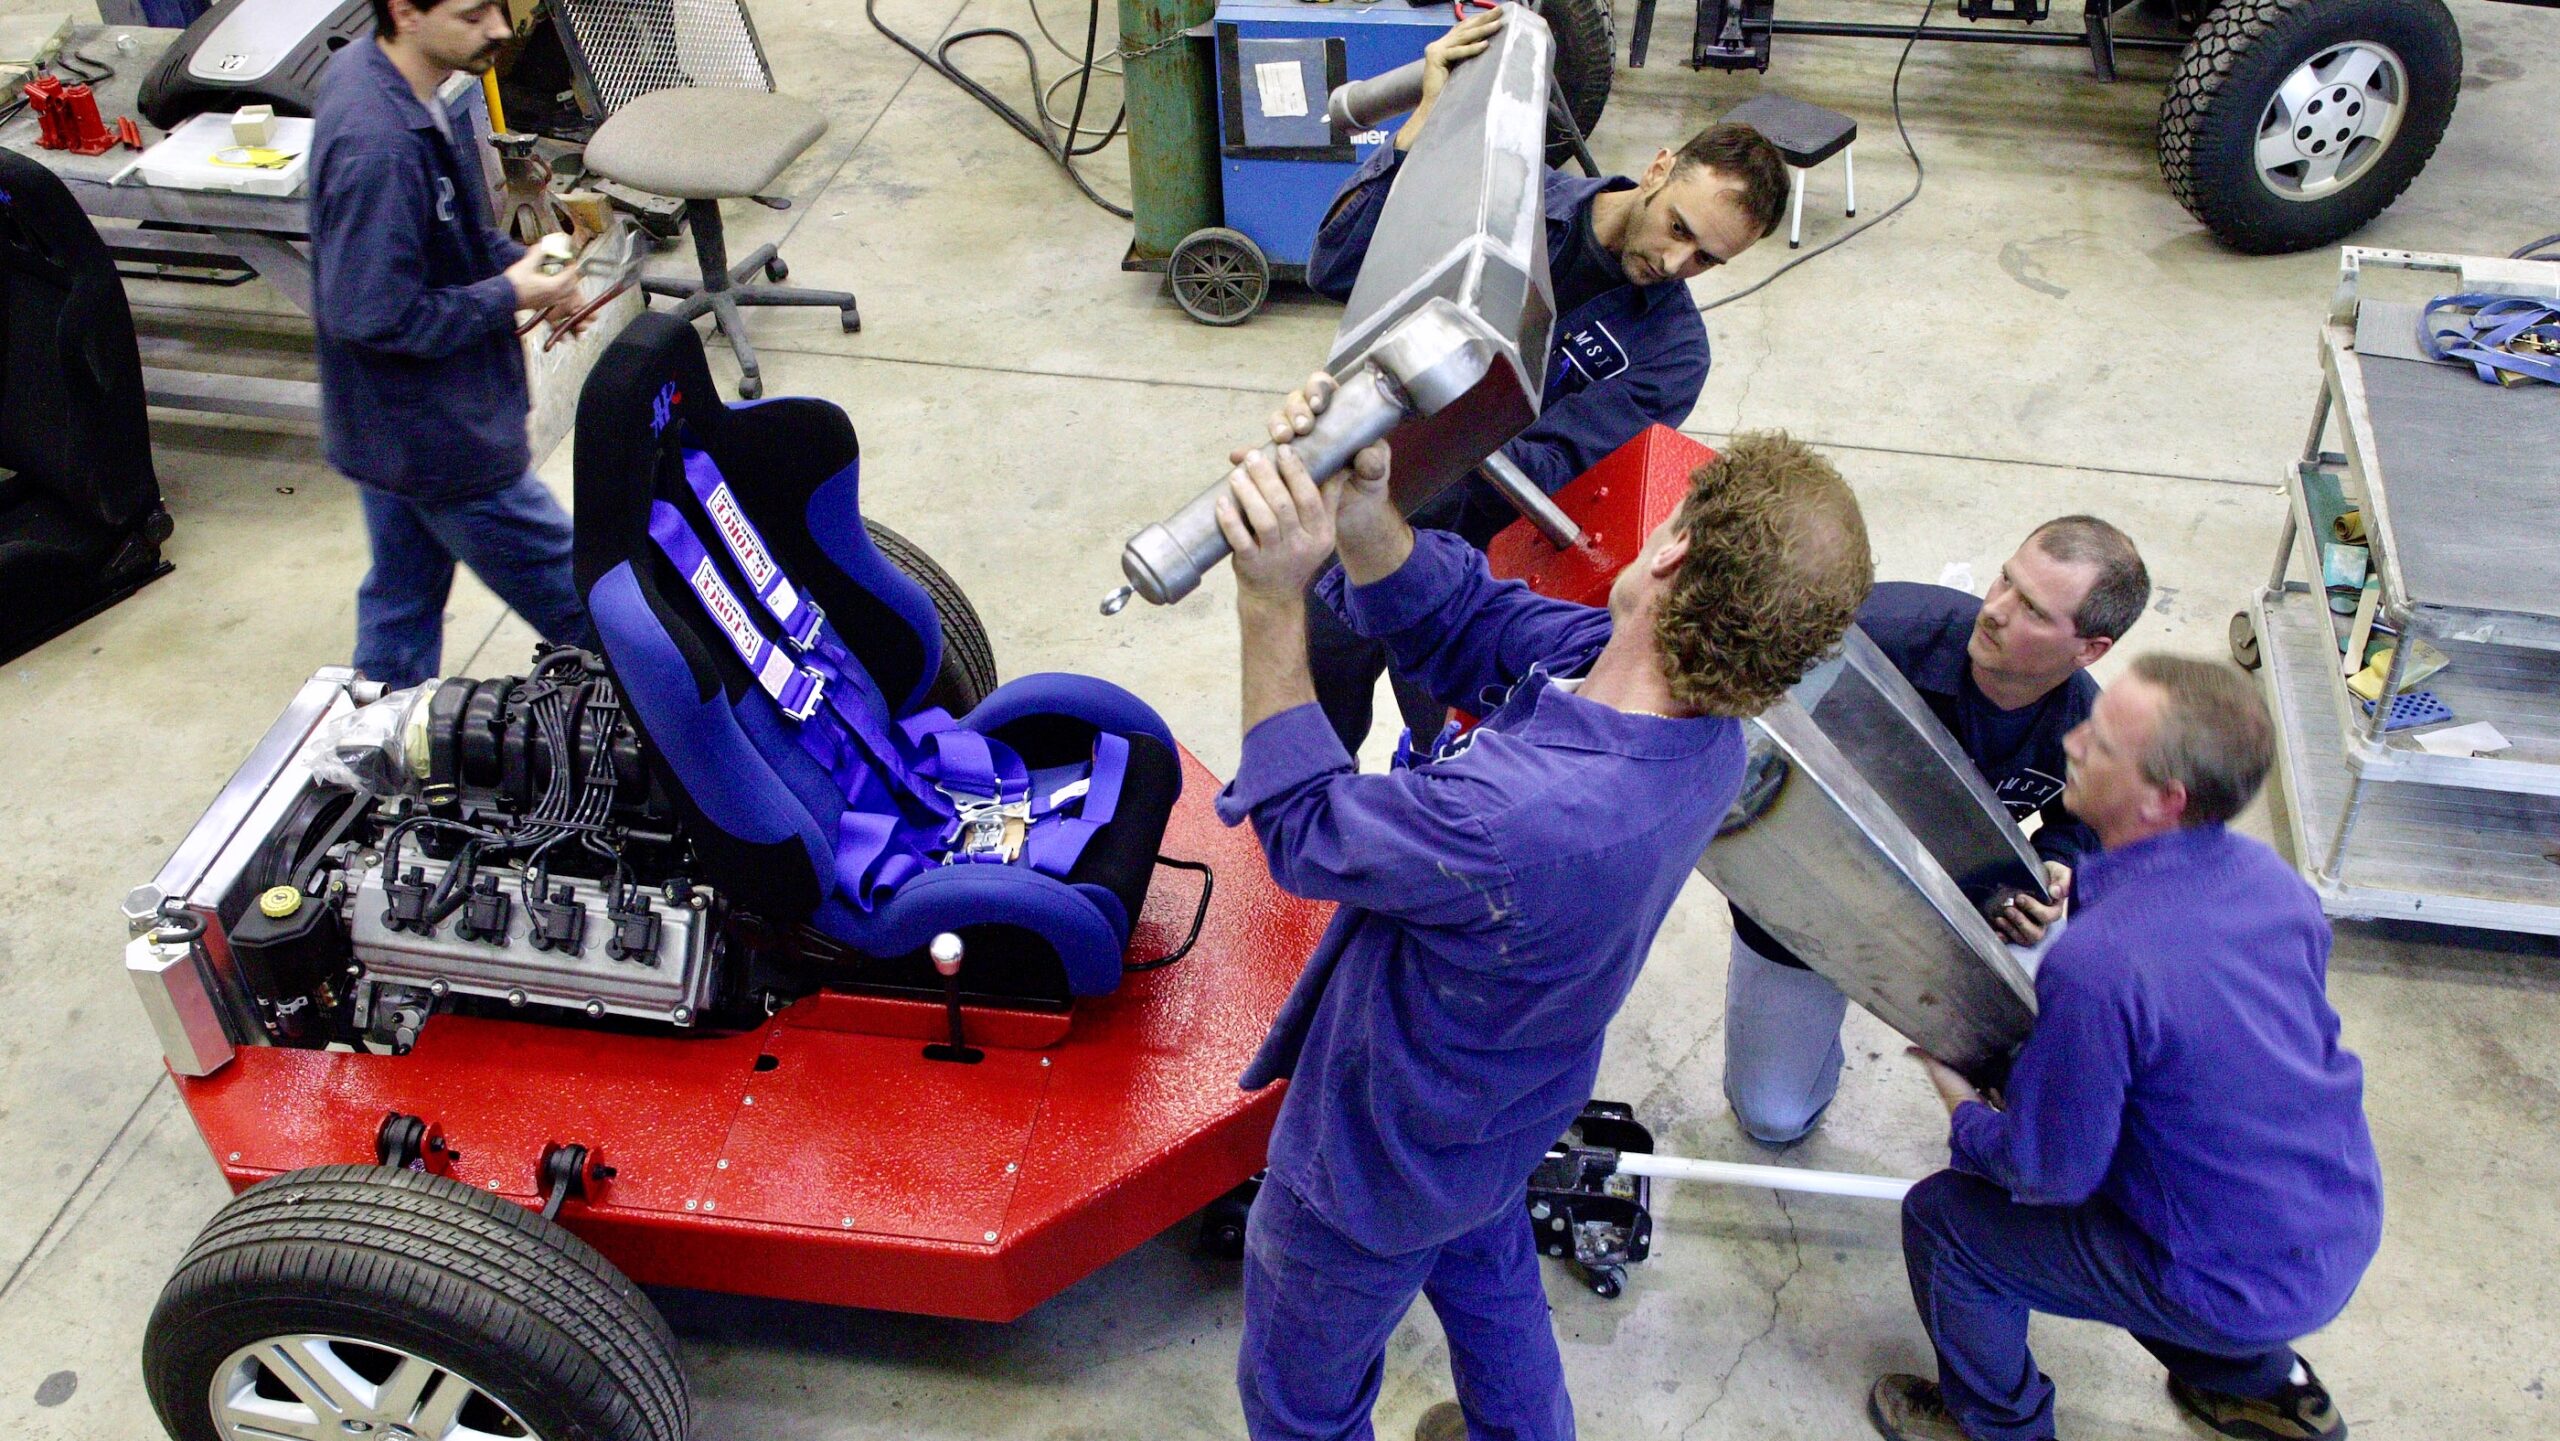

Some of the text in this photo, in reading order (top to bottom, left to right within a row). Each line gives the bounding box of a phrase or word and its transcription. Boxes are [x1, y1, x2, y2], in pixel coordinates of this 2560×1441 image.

[1573, 329, 1613, 368] MSX
[720, 493, 769, 570] RACING GEAR
